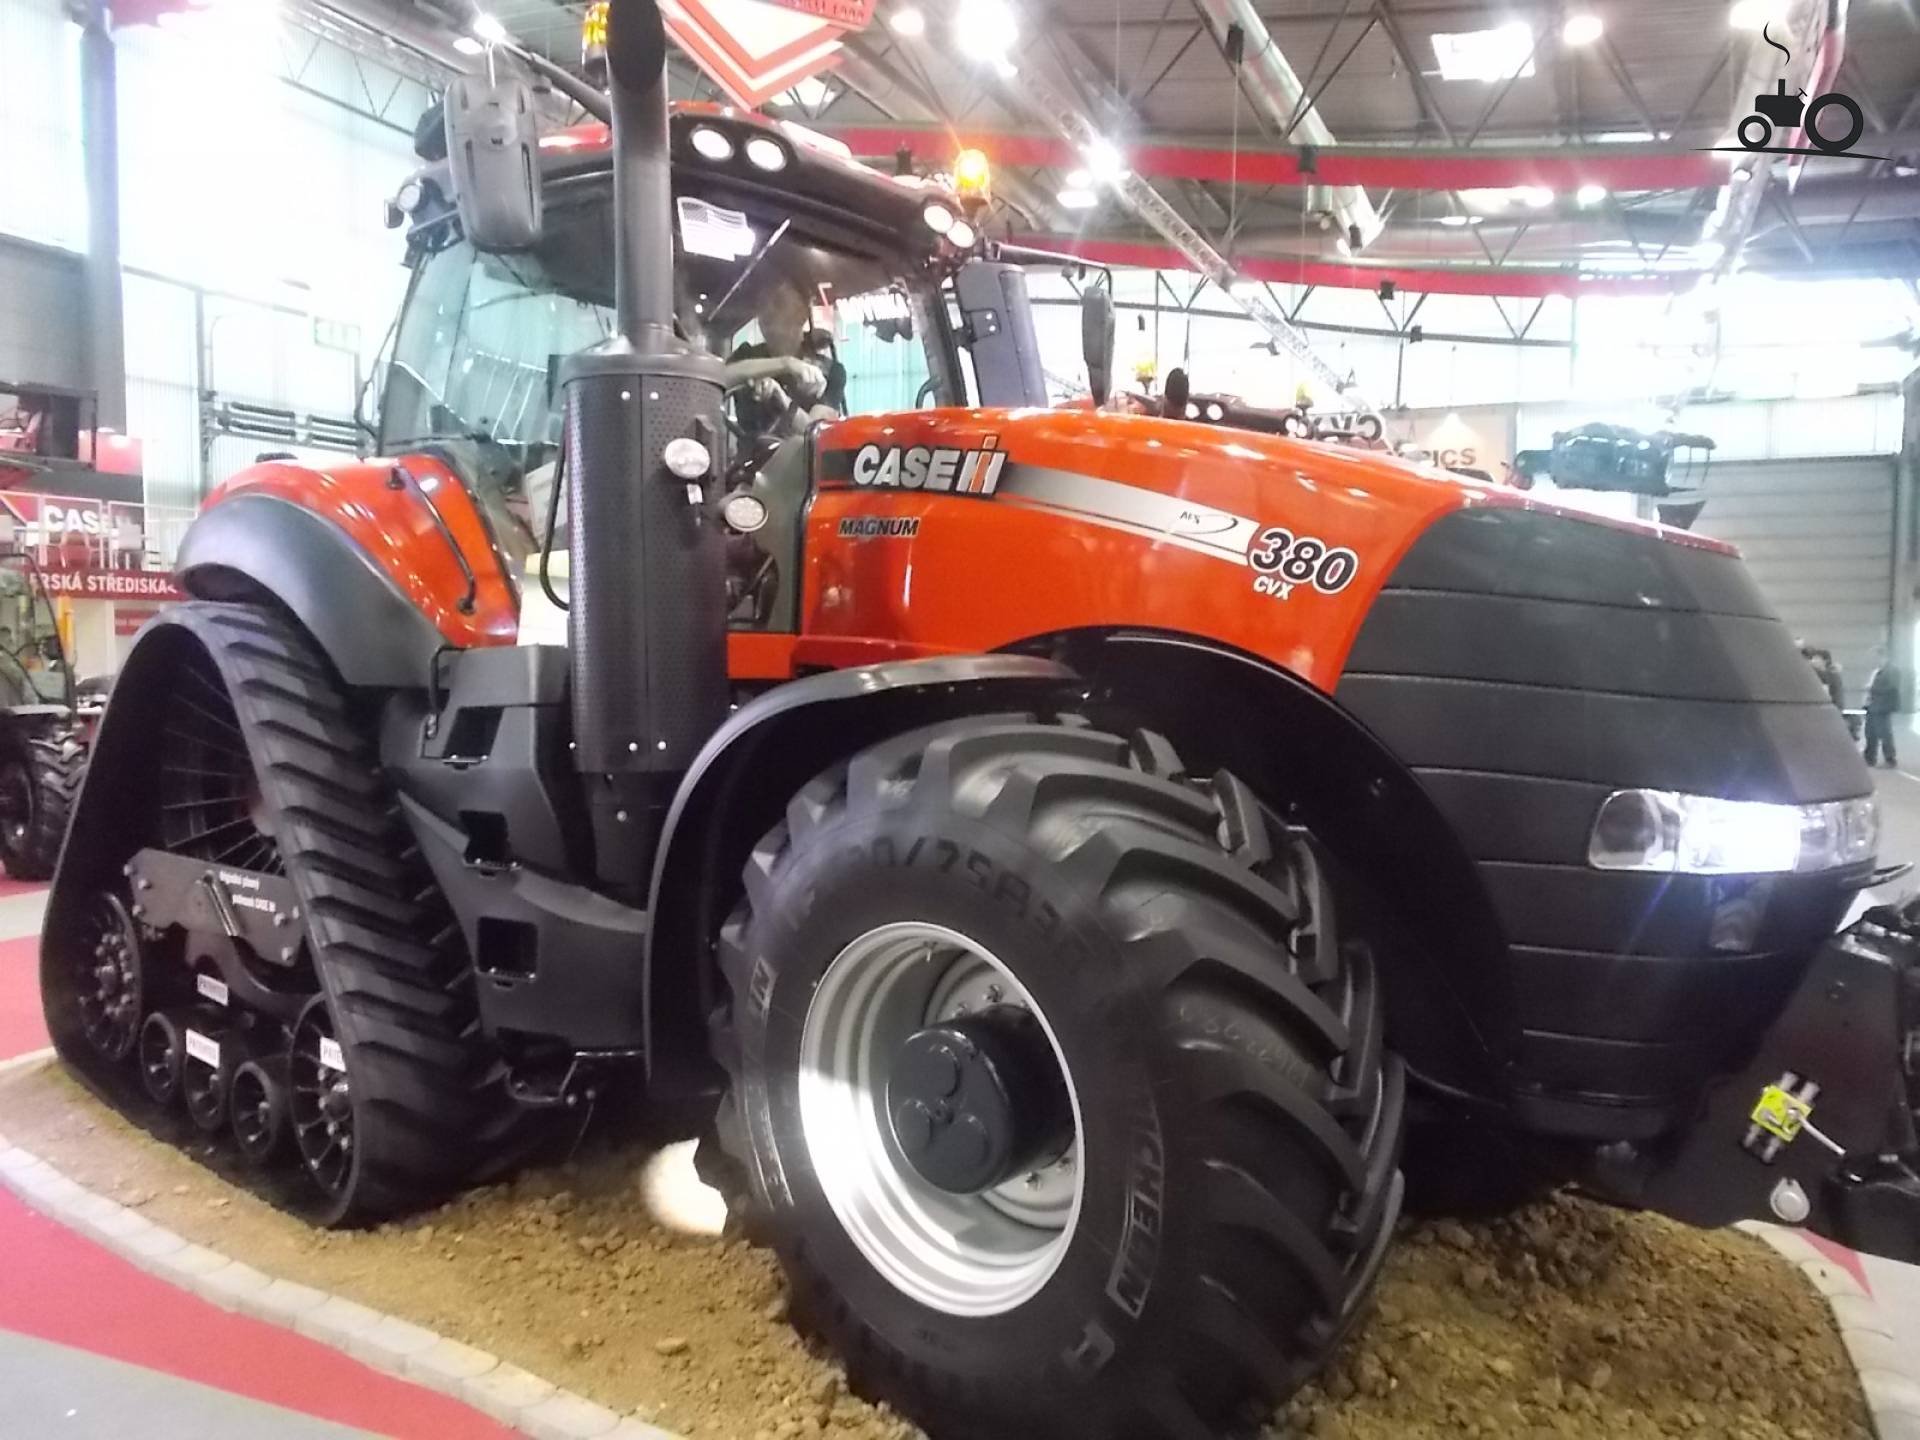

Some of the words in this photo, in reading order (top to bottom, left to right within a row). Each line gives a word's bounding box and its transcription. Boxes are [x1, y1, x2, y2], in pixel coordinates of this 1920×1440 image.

[839, 517, 920, 537] MAGNUM
[1250, 528, 1358, 594] 380
[1253, 576, 1295, 600] CVX
